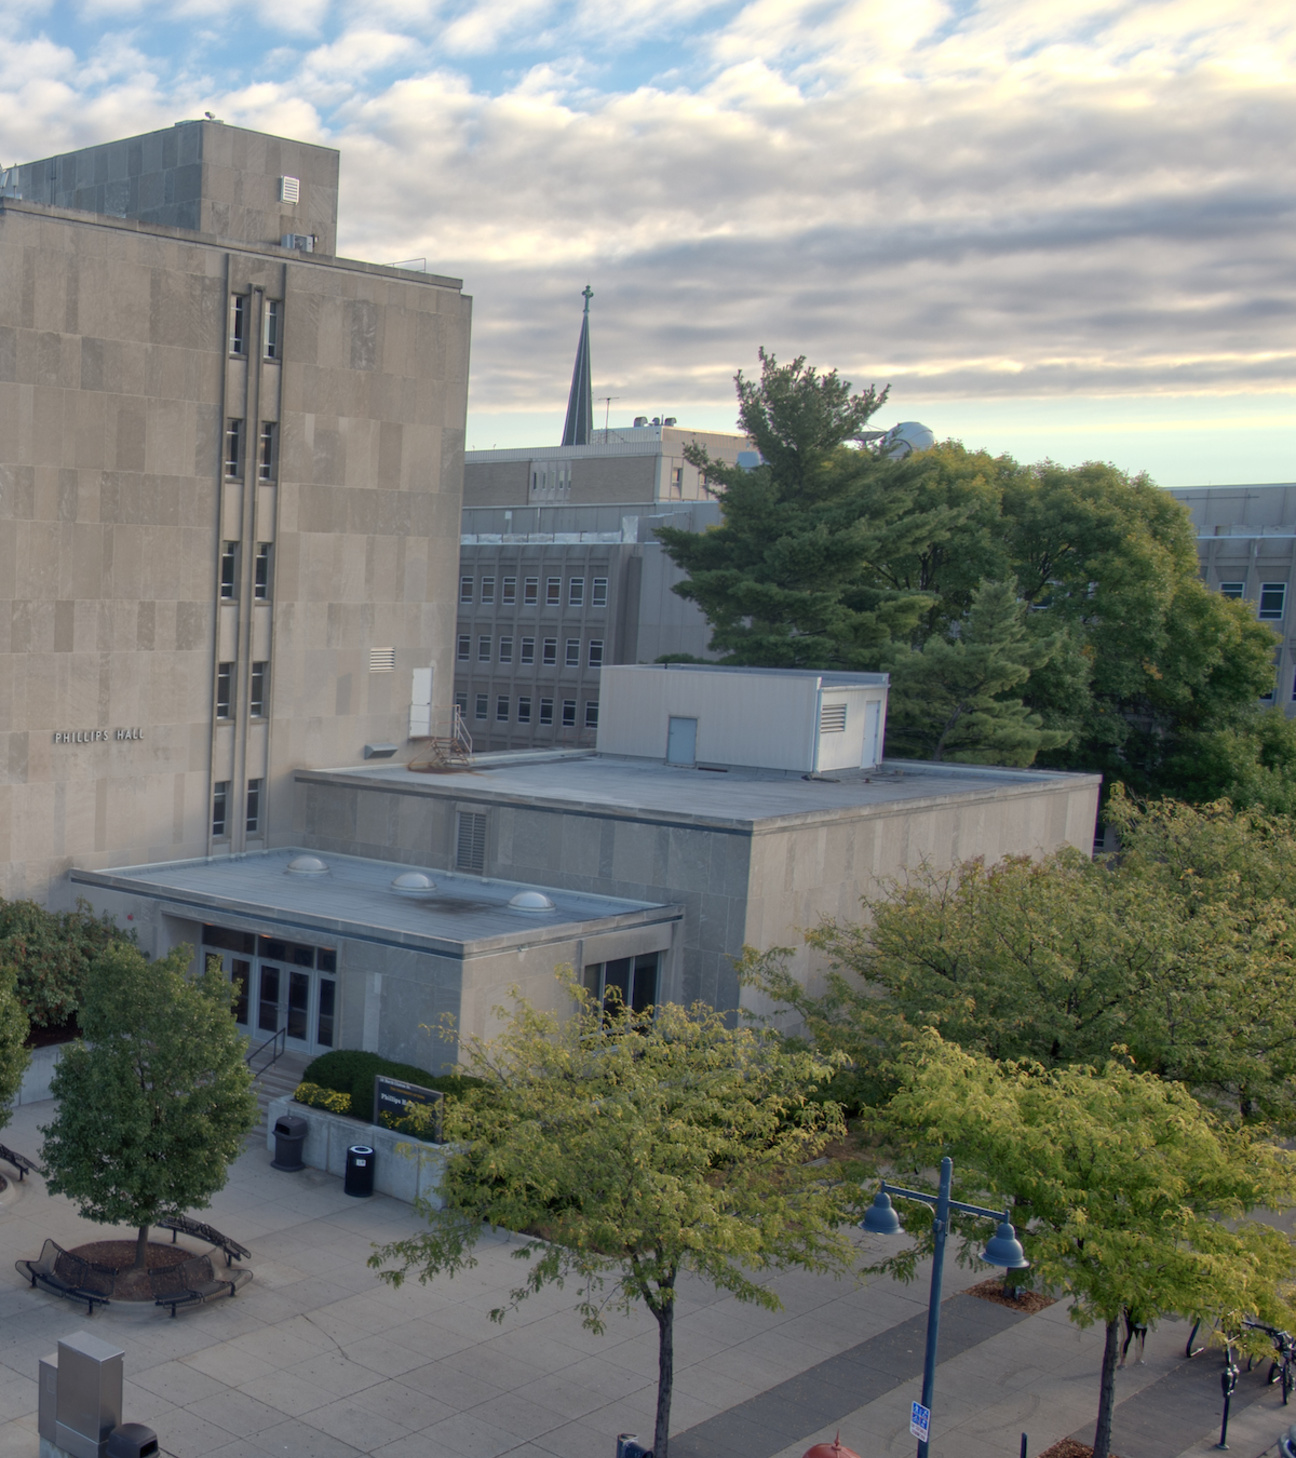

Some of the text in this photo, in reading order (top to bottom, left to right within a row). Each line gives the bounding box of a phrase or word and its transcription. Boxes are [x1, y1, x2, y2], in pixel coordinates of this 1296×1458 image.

[55, 728, 144, 743] PHILLIPS HALL
[381, 1093, 401, 1105] Phillips
